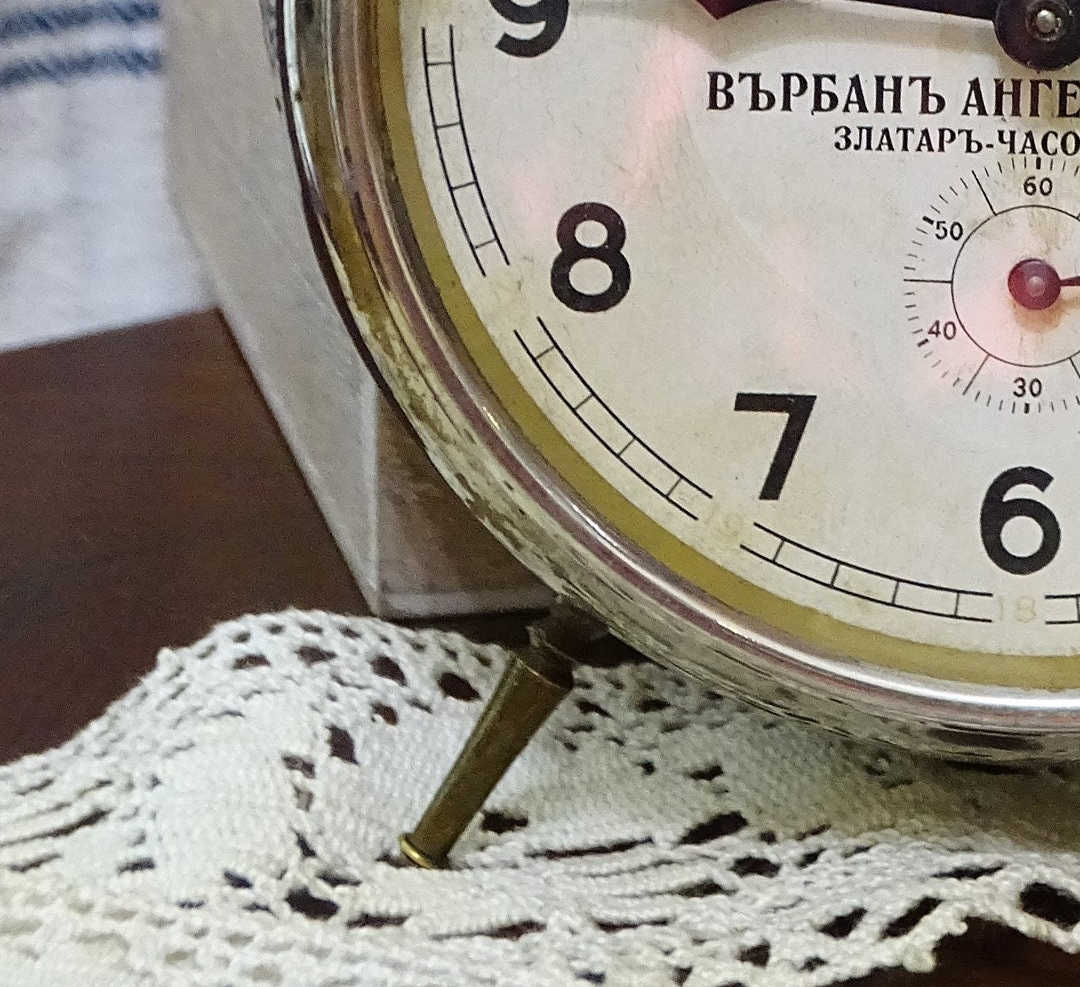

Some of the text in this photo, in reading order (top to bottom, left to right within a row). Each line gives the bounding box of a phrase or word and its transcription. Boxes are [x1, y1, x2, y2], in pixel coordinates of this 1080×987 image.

[706, 71, 946, 116] ВЪРБАНЪ
[1023, 175, 1053, 197] 60
[935, 220, 964, 242] 50
[550, 201, 632, 314] 8
[928, 319, 957, 341] 40
[1013, 376, 1043, 398] 30
[733, 392, 818, 501] 7
[979, 465, 1062, 576] 6
